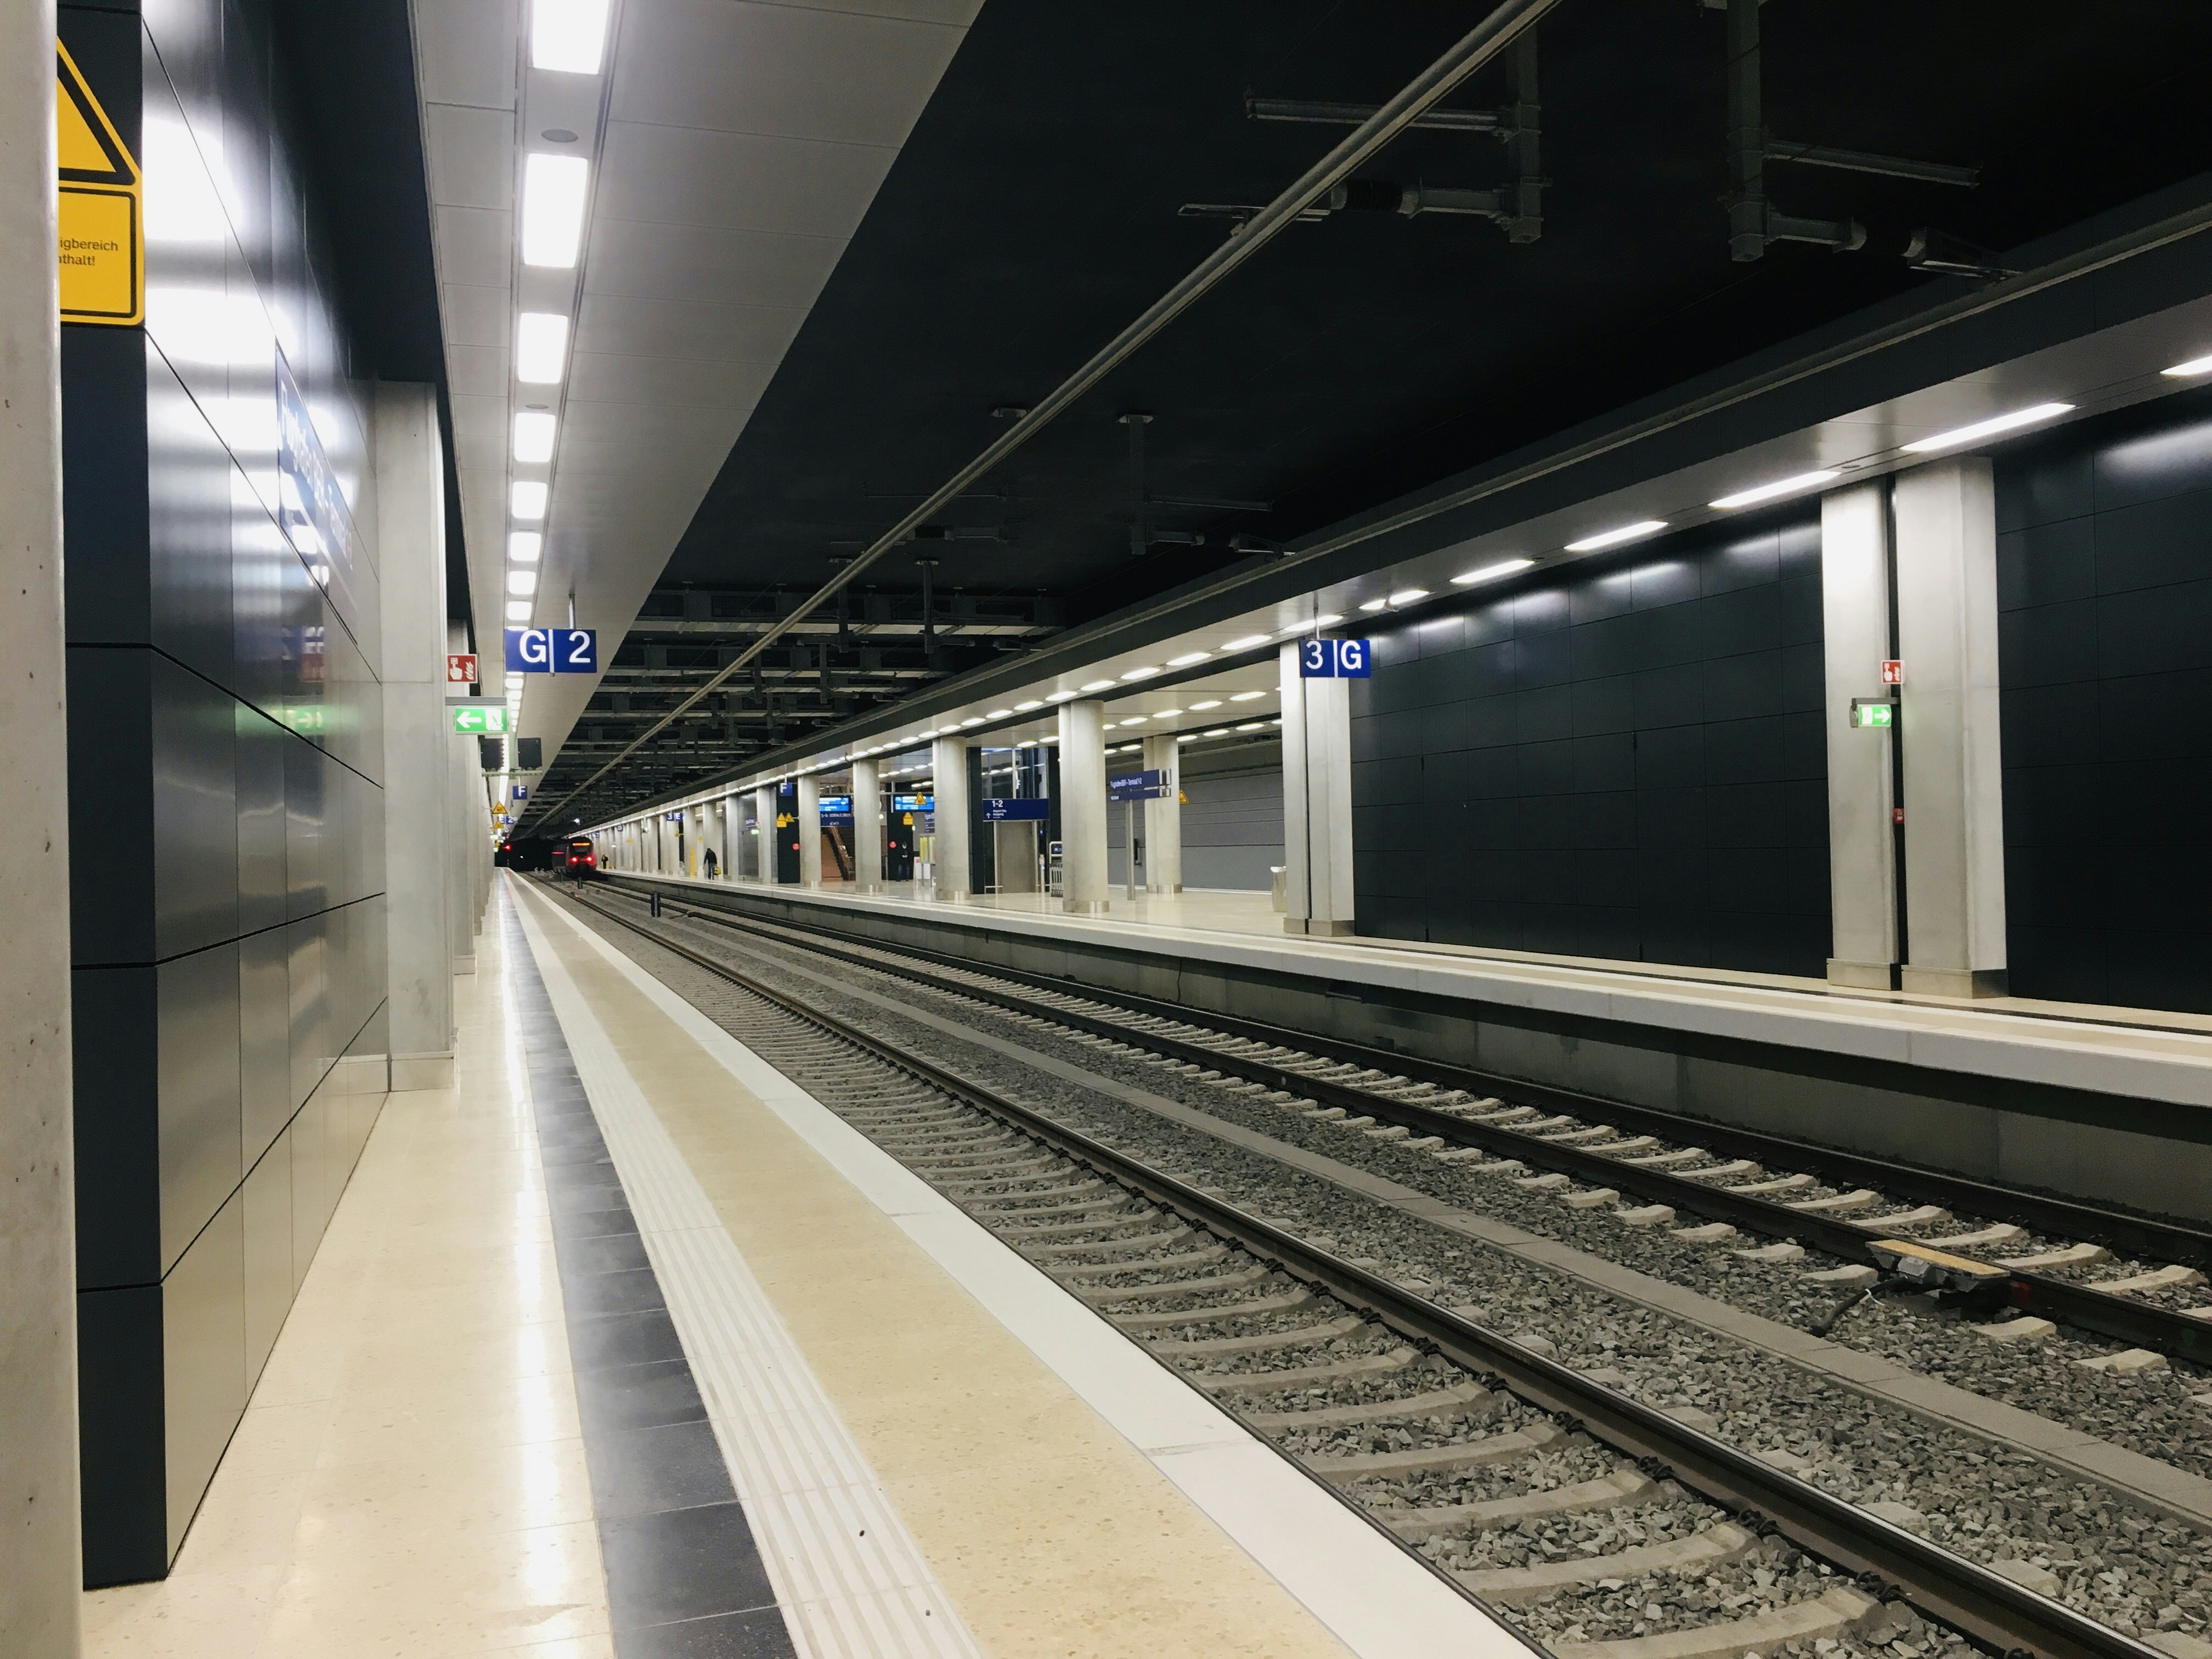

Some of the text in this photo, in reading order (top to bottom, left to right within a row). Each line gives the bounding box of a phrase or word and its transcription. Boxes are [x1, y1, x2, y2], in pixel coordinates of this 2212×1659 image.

[520, 630, 591, 663] G 2
[1306, 640, 1362, 670] 3 G
[518, 786, 526, 797] F
[781, 783, 787, 793] F
